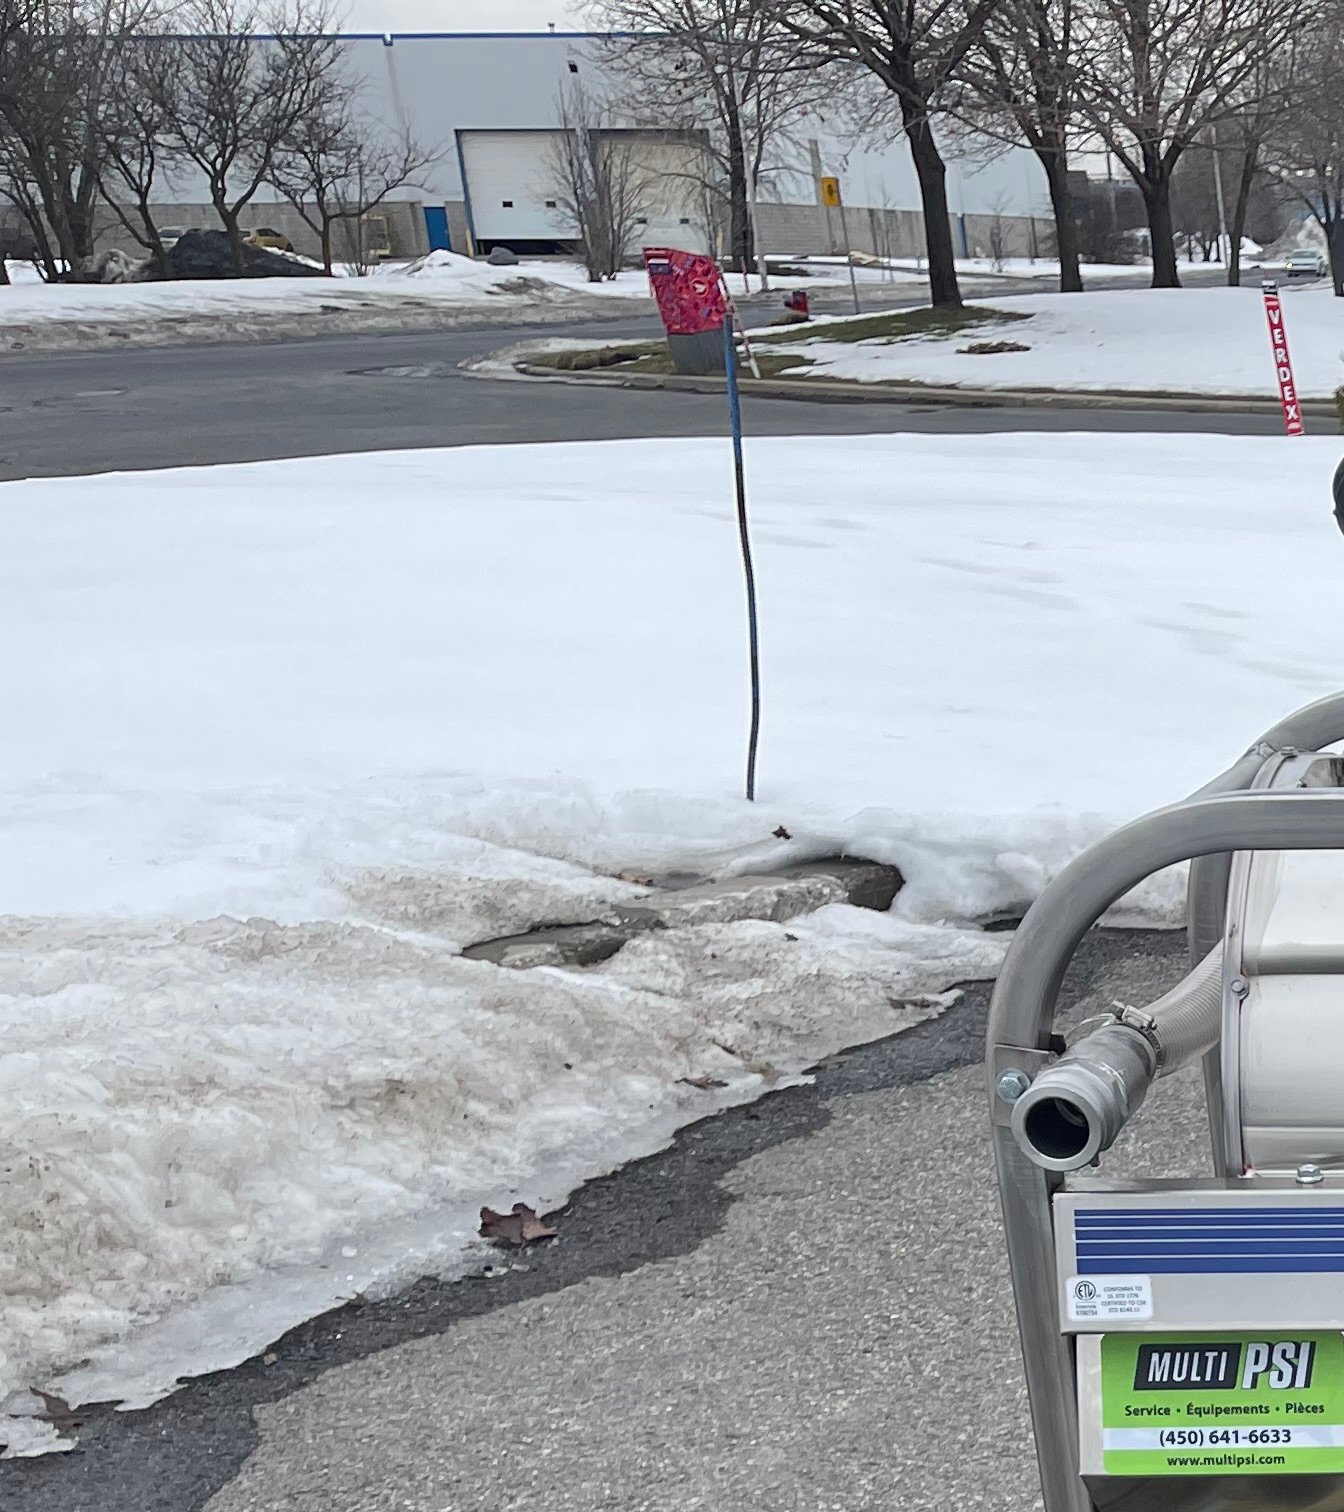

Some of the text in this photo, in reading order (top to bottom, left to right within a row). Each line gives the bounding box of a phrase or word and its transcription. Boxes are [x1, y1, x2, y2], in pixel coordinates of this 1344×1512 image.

[1268, 309, 1299, 420] VERDEX
[1147, 1341, 1316, 1389] MULTI PSI
[1124, 1402, 1325, 1418] Service Équipements Pièces
[1159, 1429, 1292, 1447] (450) 641-6633
[1167, 1453, 1285, 1467] www.multipsi.com
